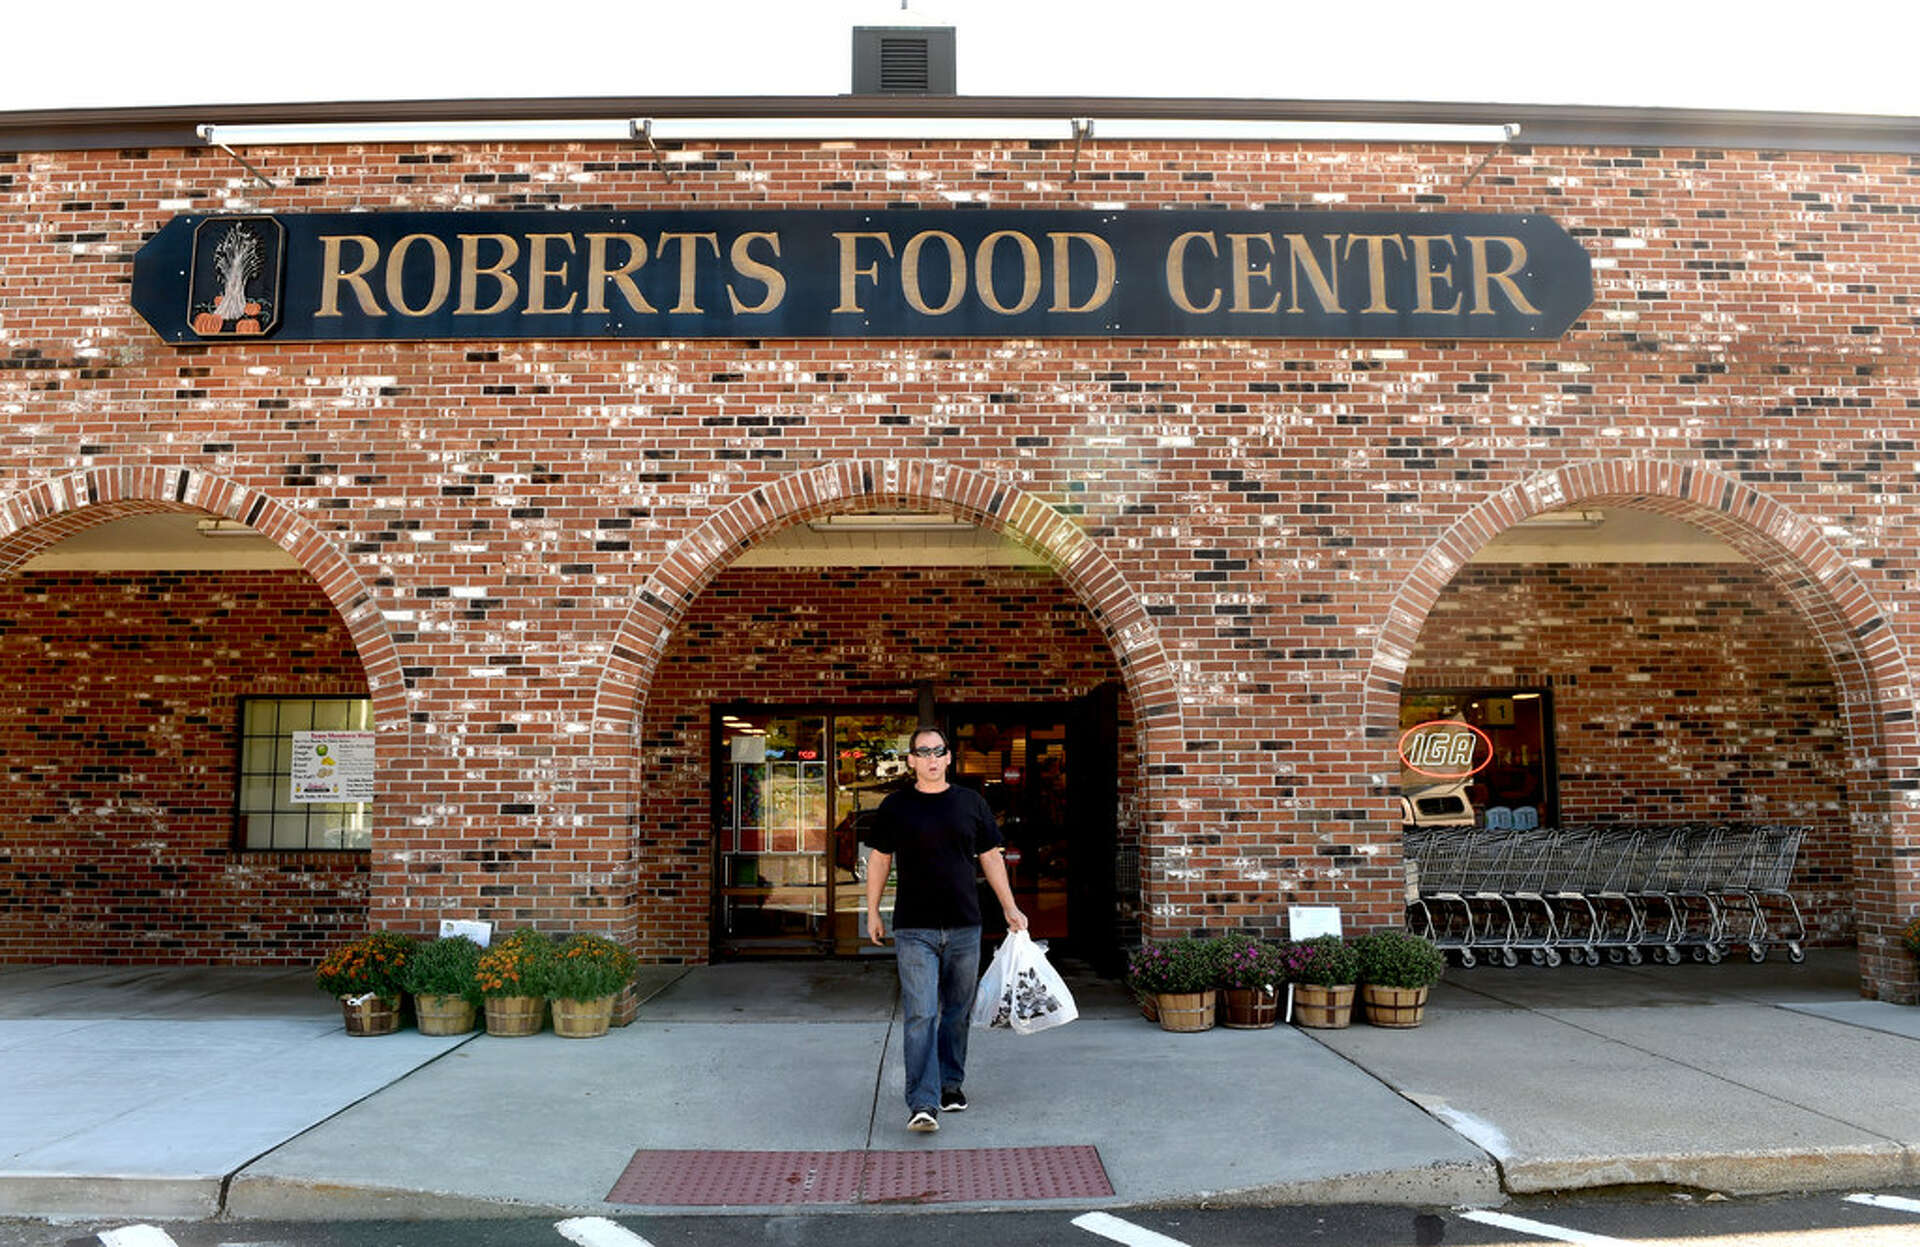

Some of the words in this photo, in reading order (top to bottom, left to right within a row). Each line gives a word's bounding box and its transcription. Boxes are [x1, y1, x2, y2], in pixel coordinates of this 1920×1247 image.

[314, 231, 786, 317] ROBERTS
[831, 229, 1116, 316] FOOD
[1165, 230, 1542, 317] CENTER
[1500, 705, 1506, 722] 1
[1410, 733, 1476, 765] IGA
